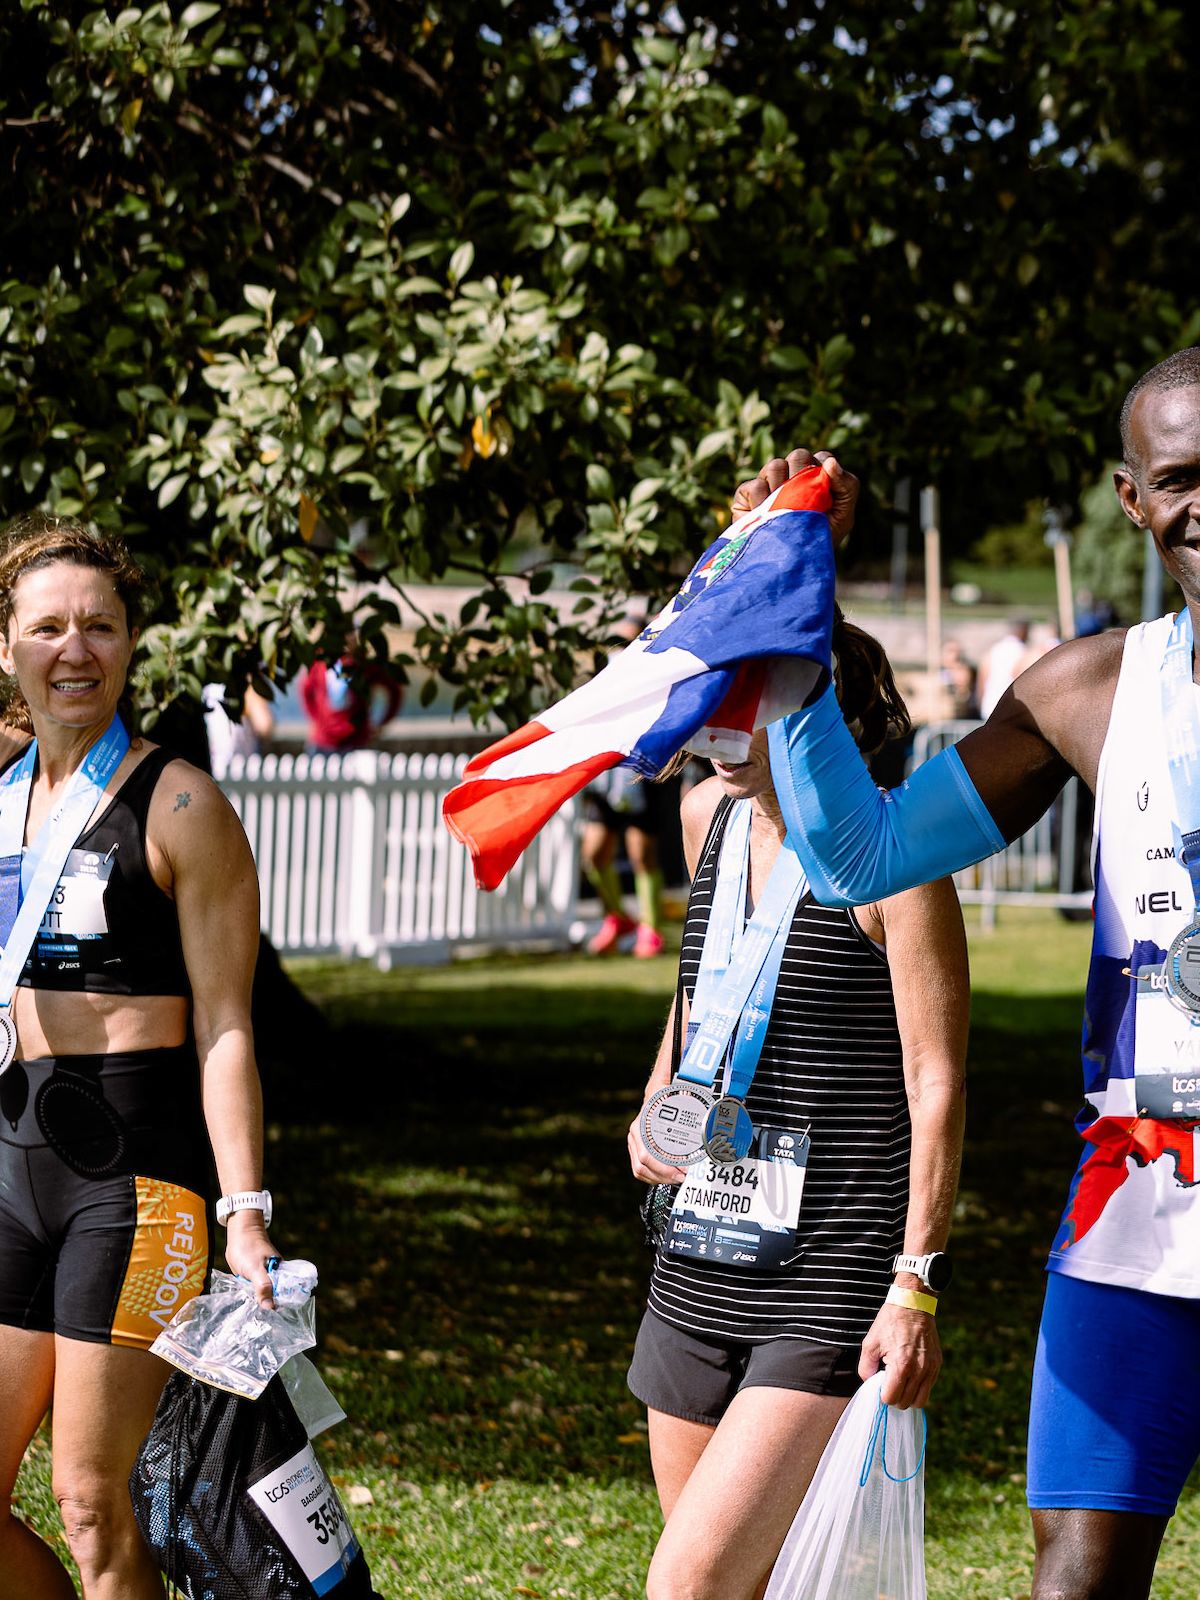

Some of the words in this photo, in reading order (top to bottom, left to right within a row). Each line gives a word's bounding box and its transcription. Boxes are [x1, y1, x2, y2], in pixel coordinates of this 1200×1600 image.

[1172, 1077, 1196, 1094] tcs
[773, 1147, 796, 1159] TATA
[684, 1186, 751, 1214] STANFORD
[264, 1481, 291, 1504] tcs
